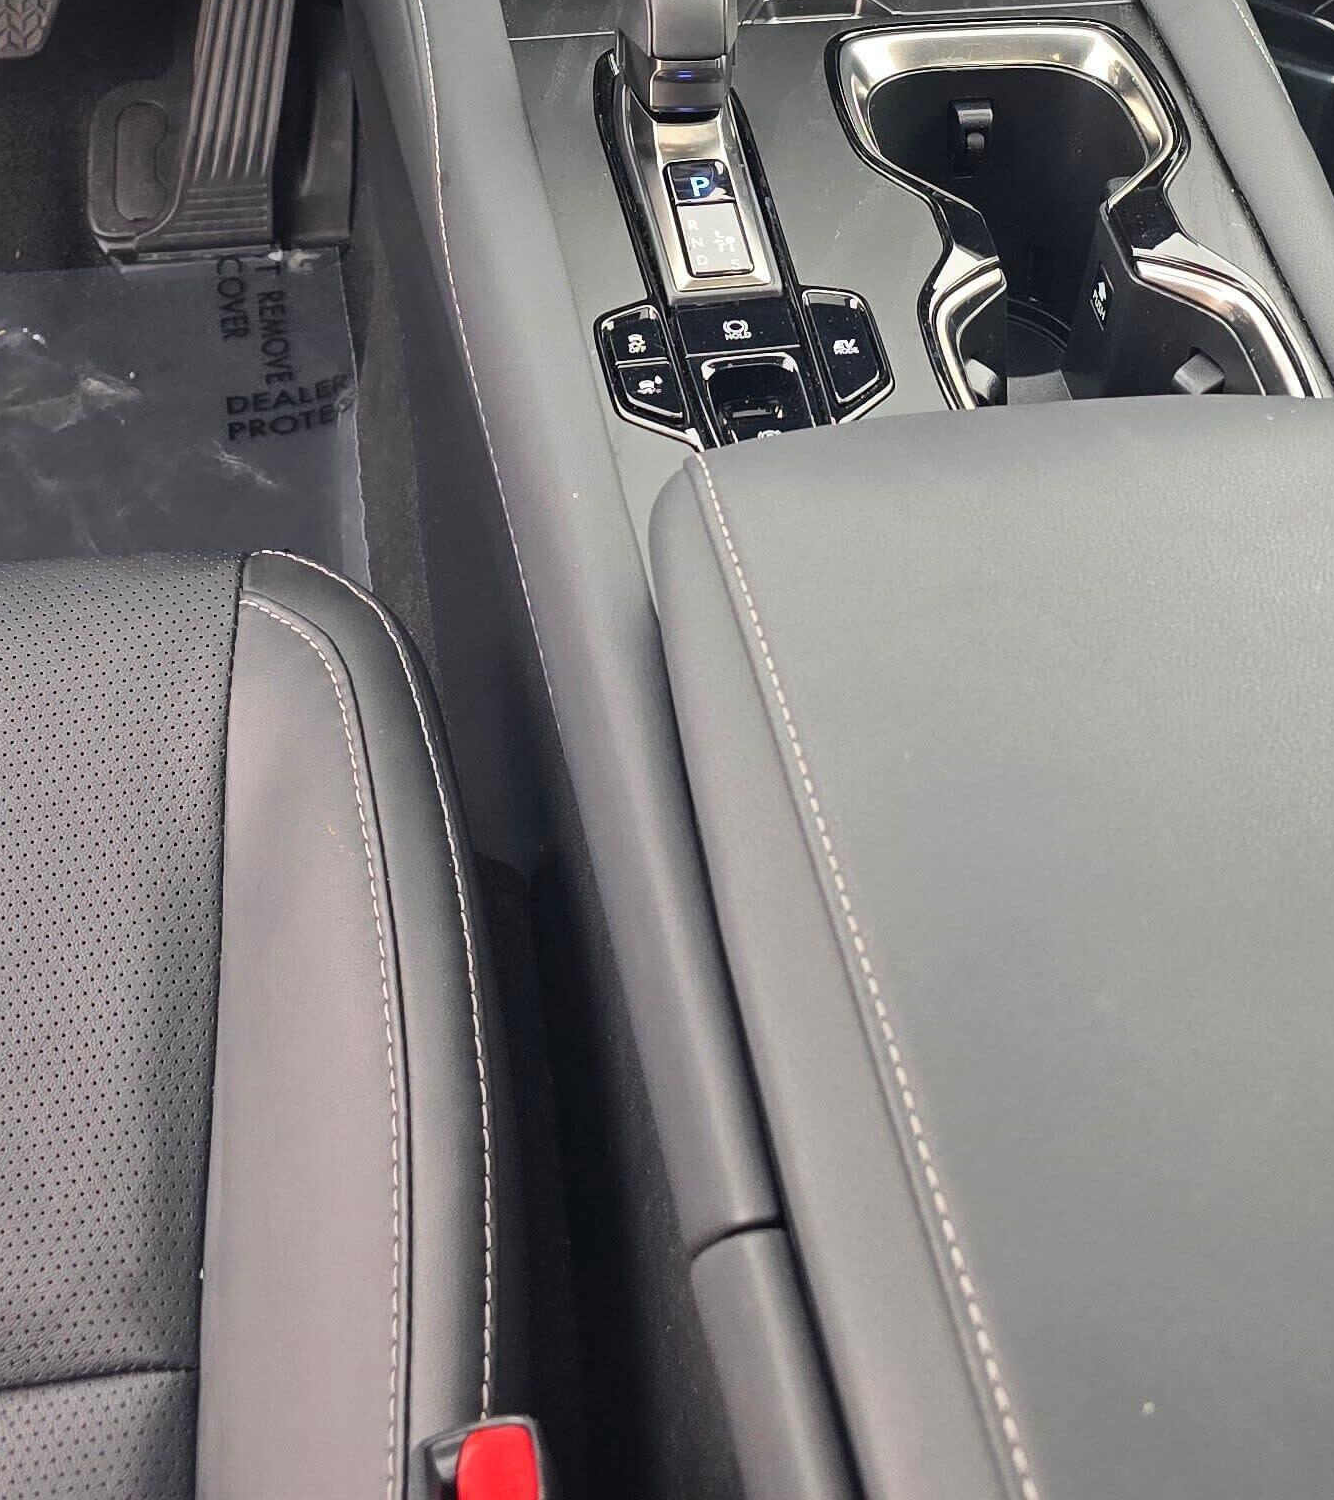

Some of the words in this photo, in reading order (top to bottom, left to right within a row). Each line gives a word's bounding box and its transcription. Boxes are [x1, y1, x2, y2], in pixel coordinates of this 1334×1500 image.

[689, 176, 710, 197] P
[686, 219, 699, 231] R
[690, 236, 705, 249] N
[695, 254, 709, 266] D
[216, 255, 249, 341] COVER
[255, 289, 294, 385] REMOVE
[833, 338, 856, 350] EV
[225, 373, 351, 416] DEALER
[227, 404, 338, 441] PROTE
